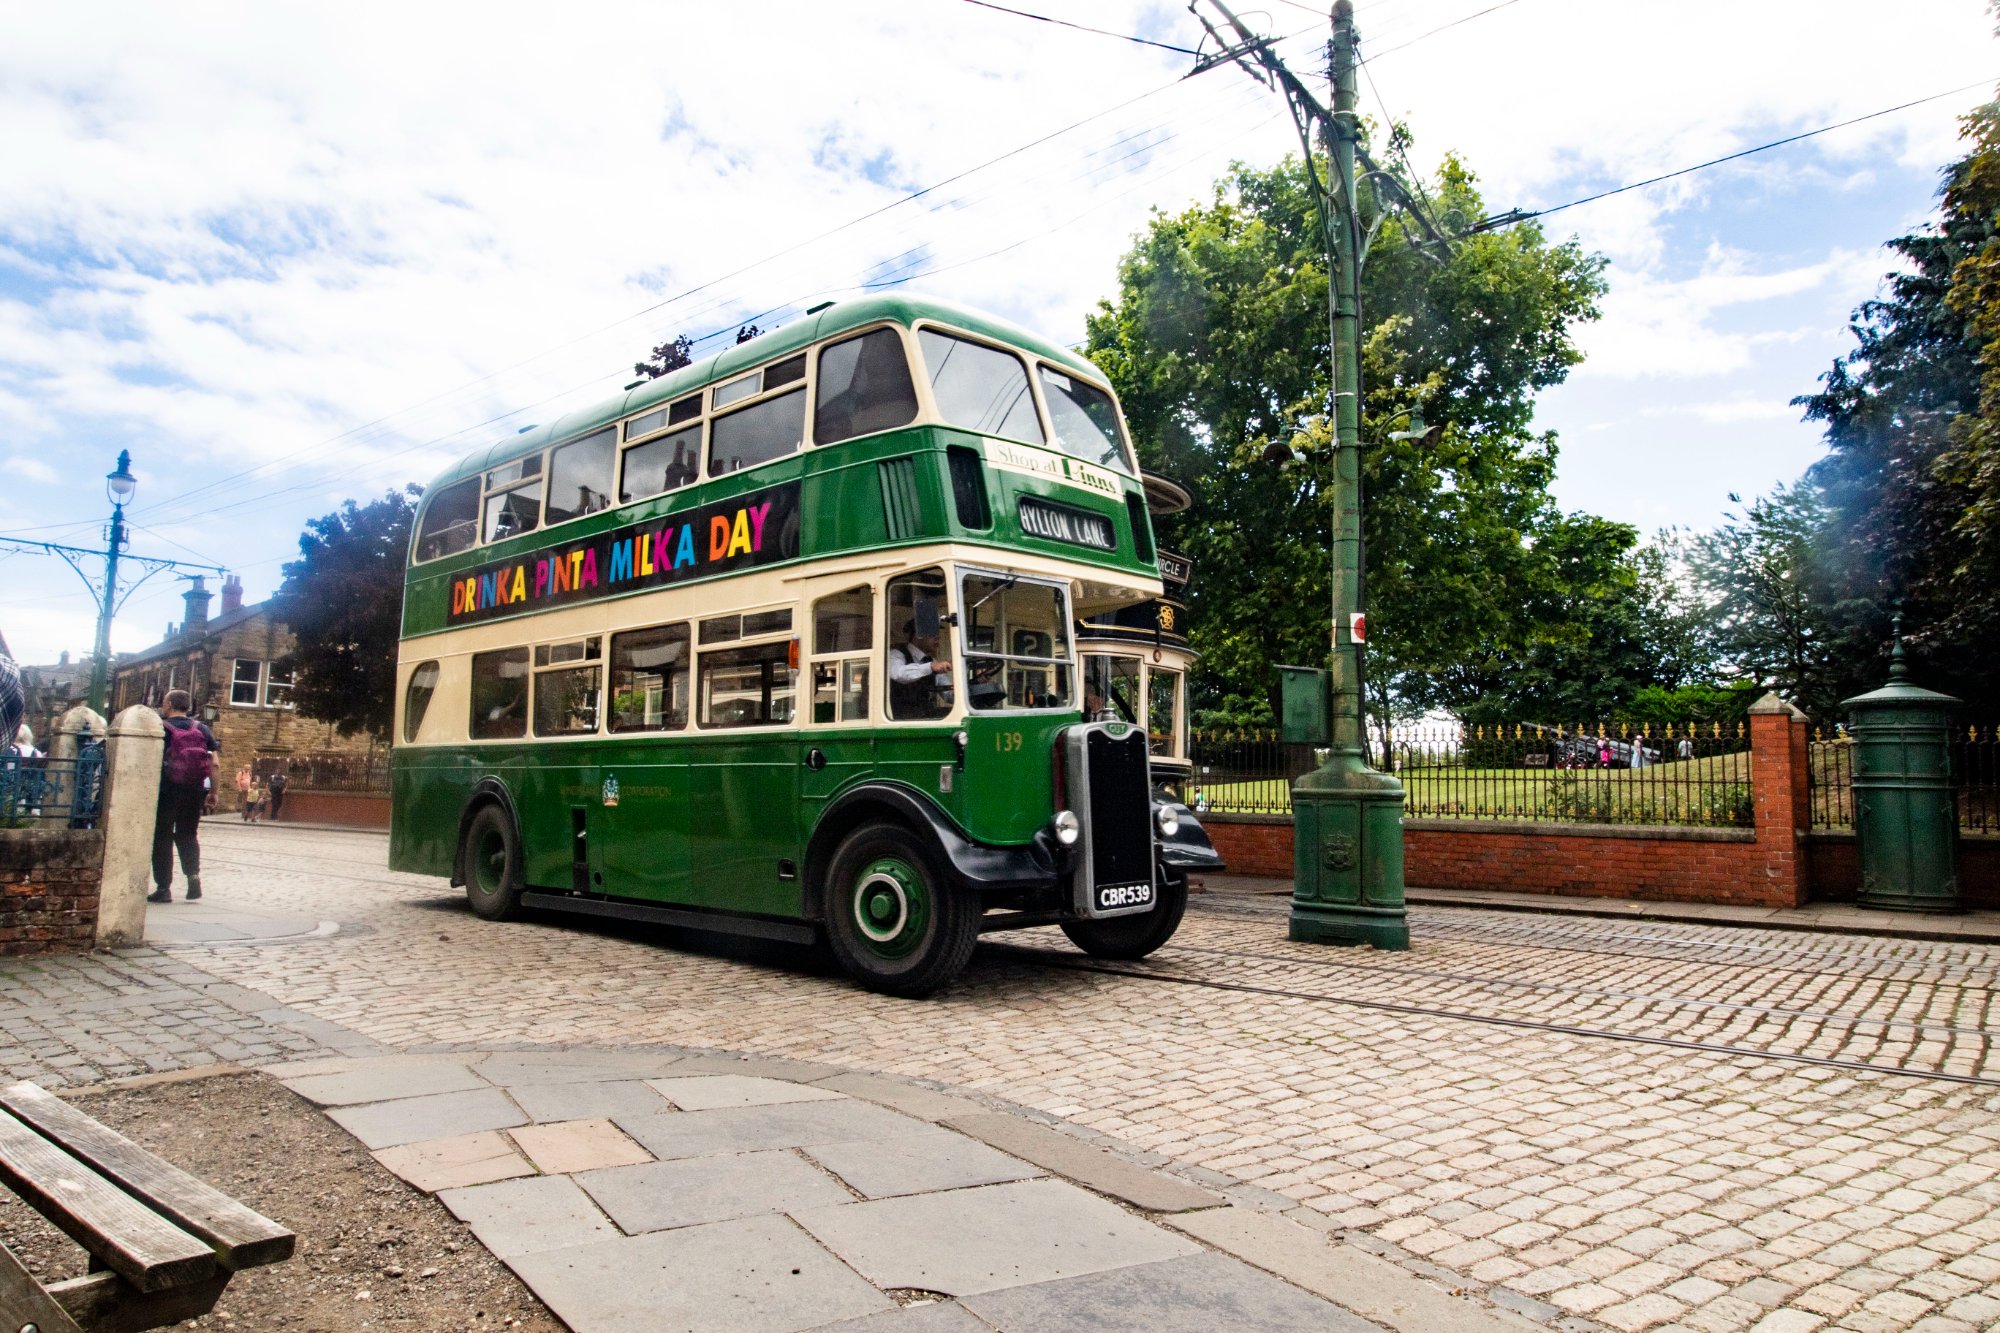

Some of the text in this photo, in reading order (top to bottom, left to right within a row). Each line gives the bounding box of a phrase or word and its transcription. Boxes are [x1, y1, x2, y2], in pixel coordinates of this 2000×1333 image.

[997, 445, 1038, 469] Shop
[1019, 504, 1110, 548] HYLTON LANE
[453, 502, 772, 616] DRINKA PINTA MILKA DAY
[1158, 558, 1180, 576] IRCLE
[996, 732, 1023, 752] 139
[1100, 885, 1151, 907] CBR539
